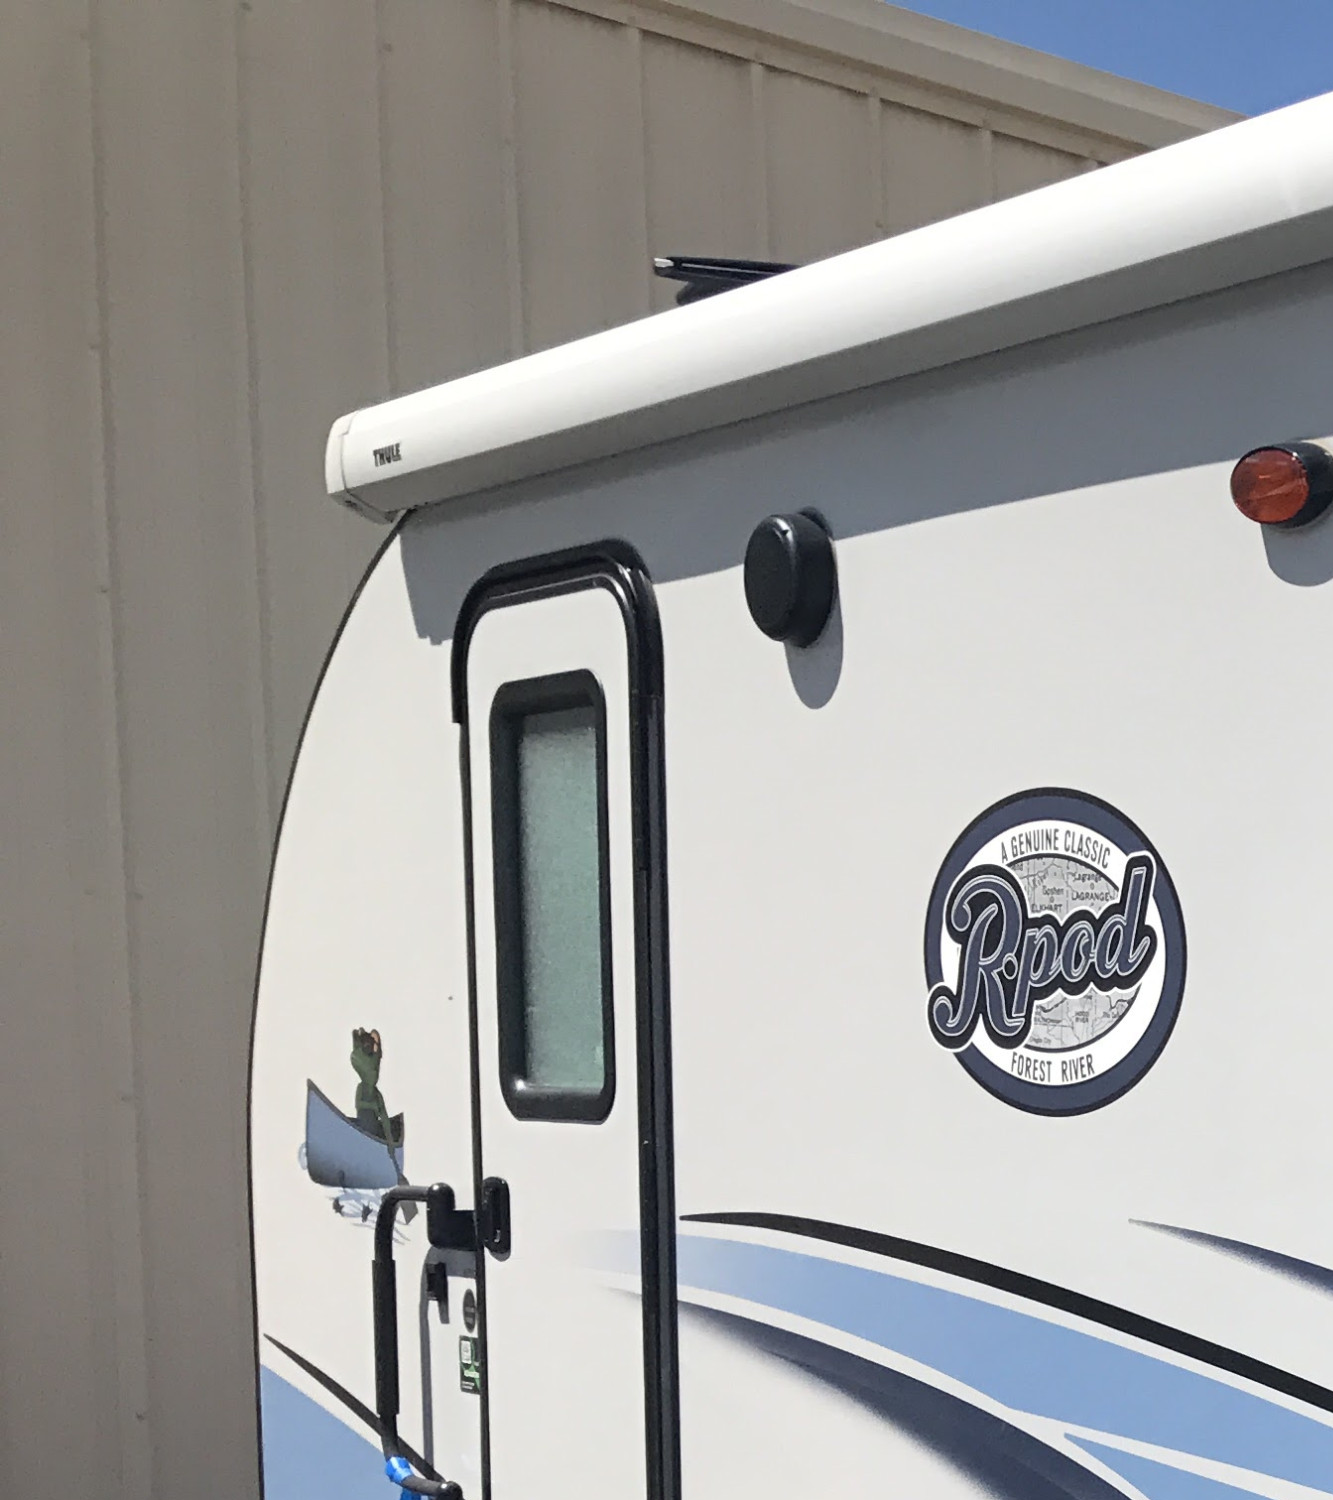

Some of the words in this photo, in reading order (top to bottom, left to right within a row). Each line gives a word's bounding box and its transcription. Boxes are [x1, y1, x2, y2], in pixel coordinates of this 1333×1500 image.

[372, 442, 402, 467] THULE
[1000, 842, 1009, 864] A
[1011, 828, 1060, 857] GENUINE
[1063, 829, 1111, 869] CLASSIC
[1071, 891, 1109, 902] LAGRANGE
[1011, 1052, 1053, 1083] FOREST
[1061, 1053, 1095, 1083] RIVER
